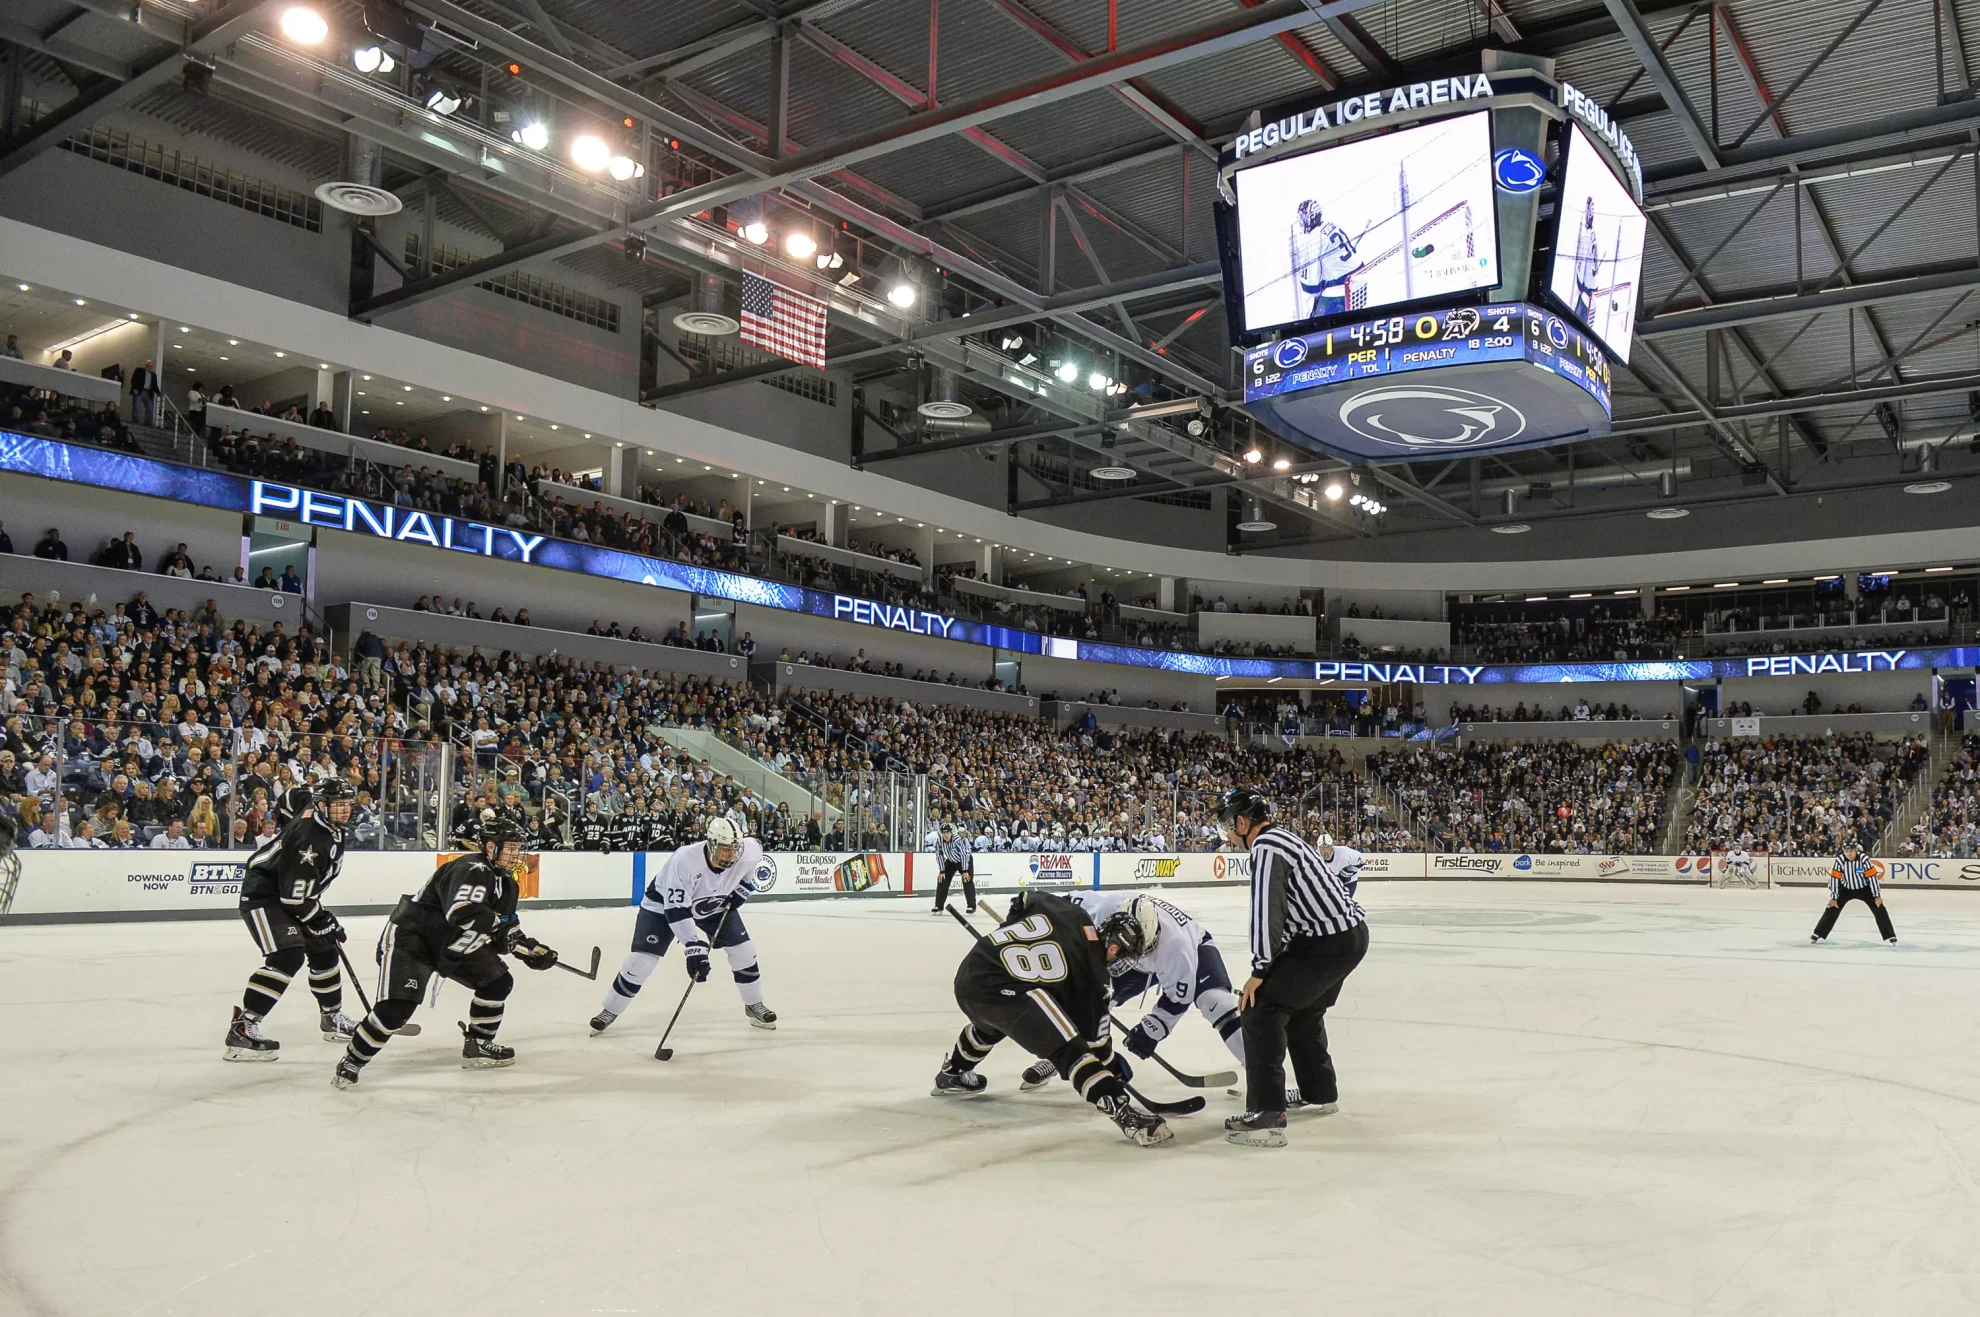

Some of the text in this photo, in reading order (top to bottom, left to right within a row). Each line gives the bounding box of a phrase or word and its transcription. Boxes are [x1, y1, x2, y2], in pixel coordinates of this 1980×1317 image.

[1235, 73, 1494, 159] PEGULA ICE ARENA
[1563, 82, 1634, 167] PEGULA ICE
[1487, 306, 1517, 316] SHOTS
[1350, 316, 1405, 347] 4:58
[1493, 315, 1511, 332] 4
[1531, 320, 1541, 336] 6
[1326, 333, 1334, 356] 1
[1468, 339, 1481, 349] 18
[1249, 348, 1269, 361] SHOTS
[1349, 350, 1378, 365] PER
[1403, 348, 1457, 364] PENALTY
[1253, 358, 1265, 375] 6
[1292, 364, 1338, 385] PENALTY
[1361, 364, 1381, 375] TOL
[251, 480, 546, 564] PENALTY
[833, 594, 955, 638] PENALTY
[1748, 651, 1906, 676] PENALTY
[1315, 662, 1483, 684] PENALTY
[586, 831, 600, 840] 23
[651, 829, 661, 838] 10
[1040, 854, 1072, 870] RE/MAX
[1134, 856, 1181, 880] SUBWAY
[1434, 855, 1502, 871] FirstEnergy
[1514, 859, 1531, 869] pork
[1535, 858, 1581, 871] Be inspired
[127, 874, 185, 882] DOWNLOAD
[799, 866, 829, 876] The Finest
[1771, 865, 1832, 876] HIGHMARK
[1889, 862, 1941, 881] PNC
[143, 883, 169, 891] NOW
[795, 875, 833, 885] Sauce Made!
[190, 885, 241, 895] BTN2GO.
[292, 879, 316, 899] 21
[453, 884, 486, 903] 26
[667, 888, 686, 904] 23
[447, 930, 490, 955] 26
[988, 914, 1068, 983] 28
[1175, 981, 1188, 998] 9
[1097, 1014, 1111, 1038] 2
